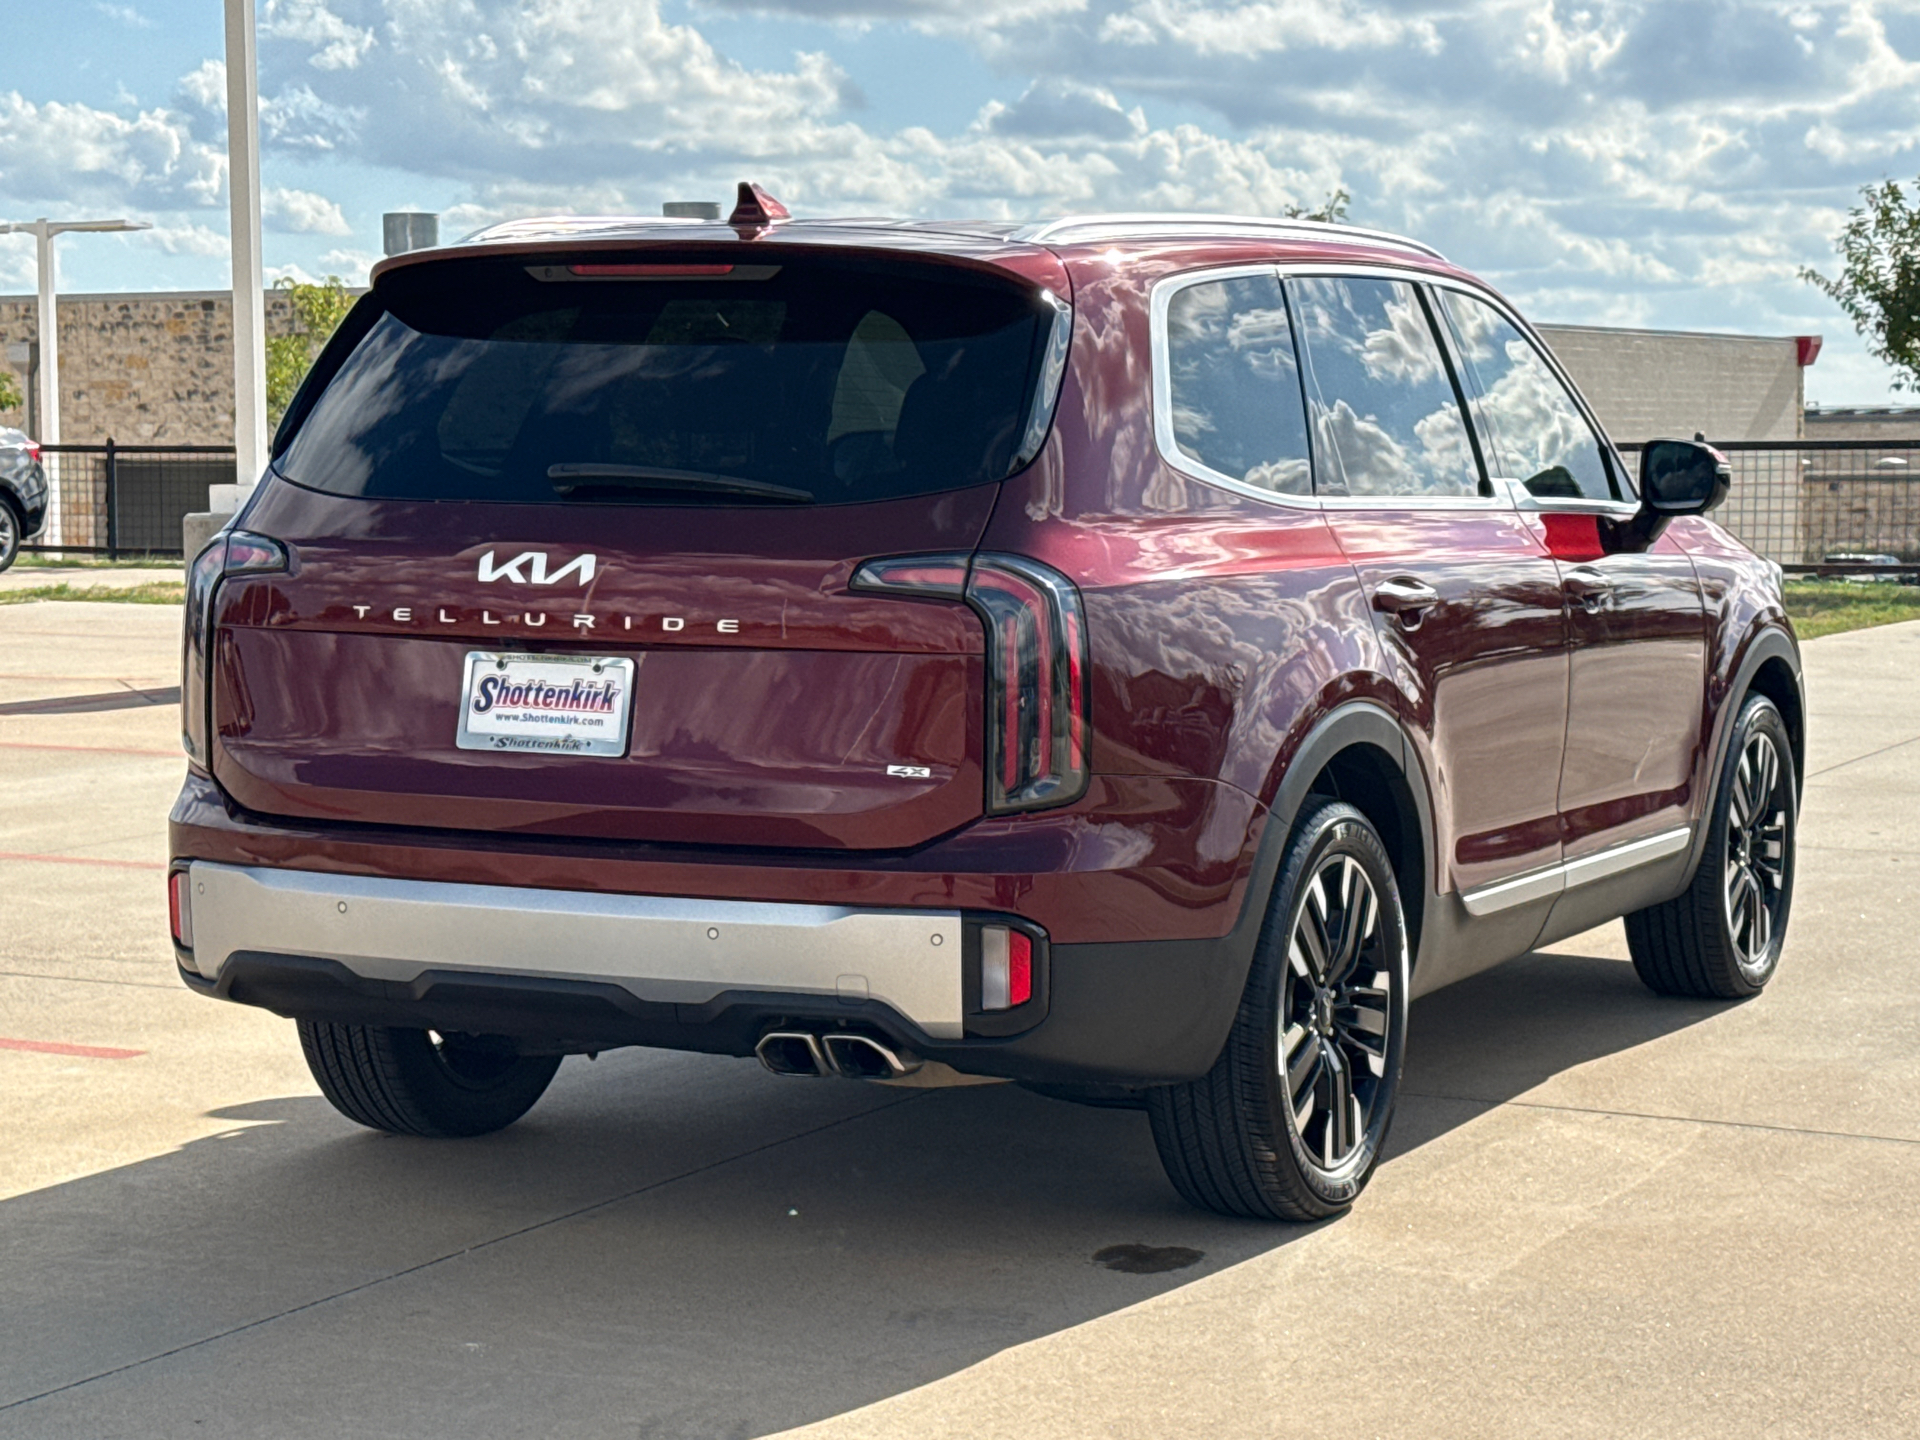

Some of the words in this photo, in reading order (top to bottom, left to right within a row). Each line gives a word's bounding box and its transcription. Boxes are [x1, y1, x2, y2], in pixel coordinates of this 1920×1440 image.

[353, 605, 740, 633] TELLURIDE
[474, 676, 617, 713] Shottenkirk
[495, 713, 604, 727] www.Shottenkirk.com
